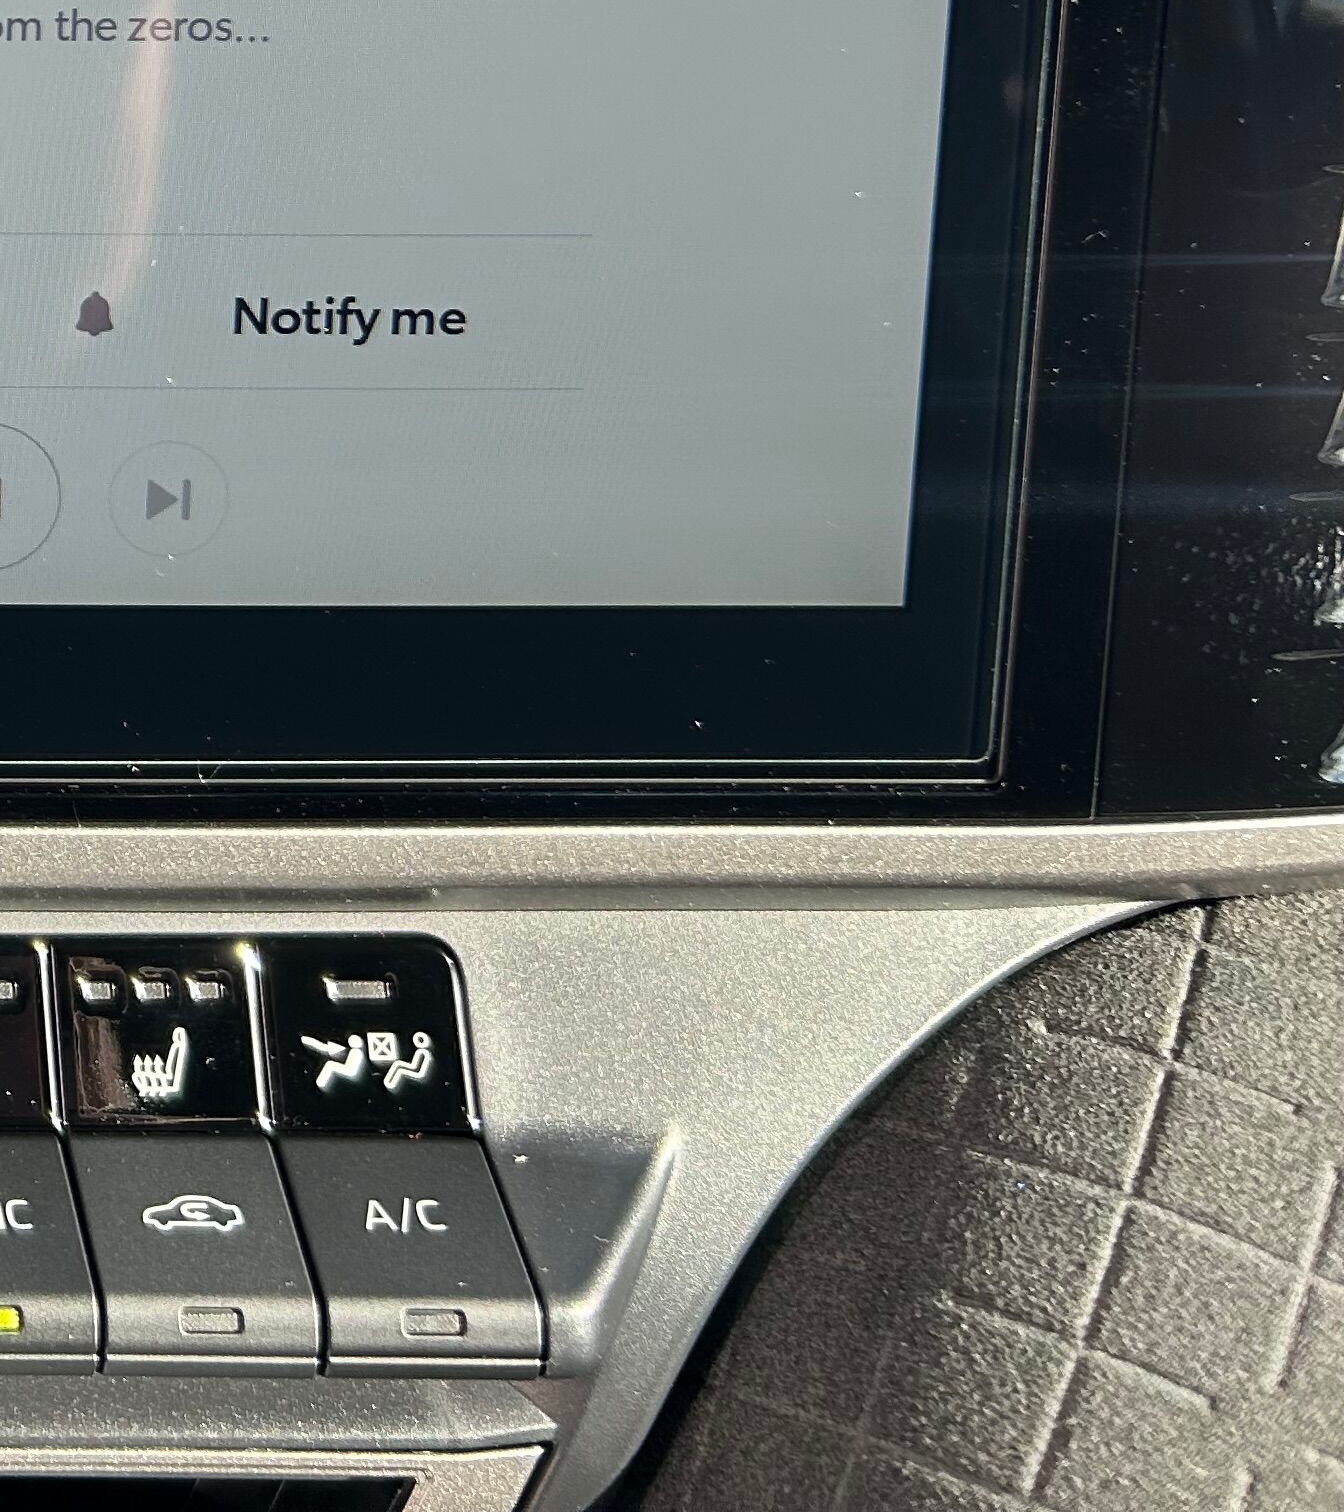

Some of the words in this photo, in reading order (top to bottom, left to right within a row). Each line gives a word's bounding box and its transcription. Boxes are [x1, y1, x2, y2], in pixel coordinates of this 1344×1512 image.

[55, 8, 117, 41] the
[234, 297, 381, 345] Notify
[392, 309, 466, 335] me
[366, 1198, 447, 1231] A/C
